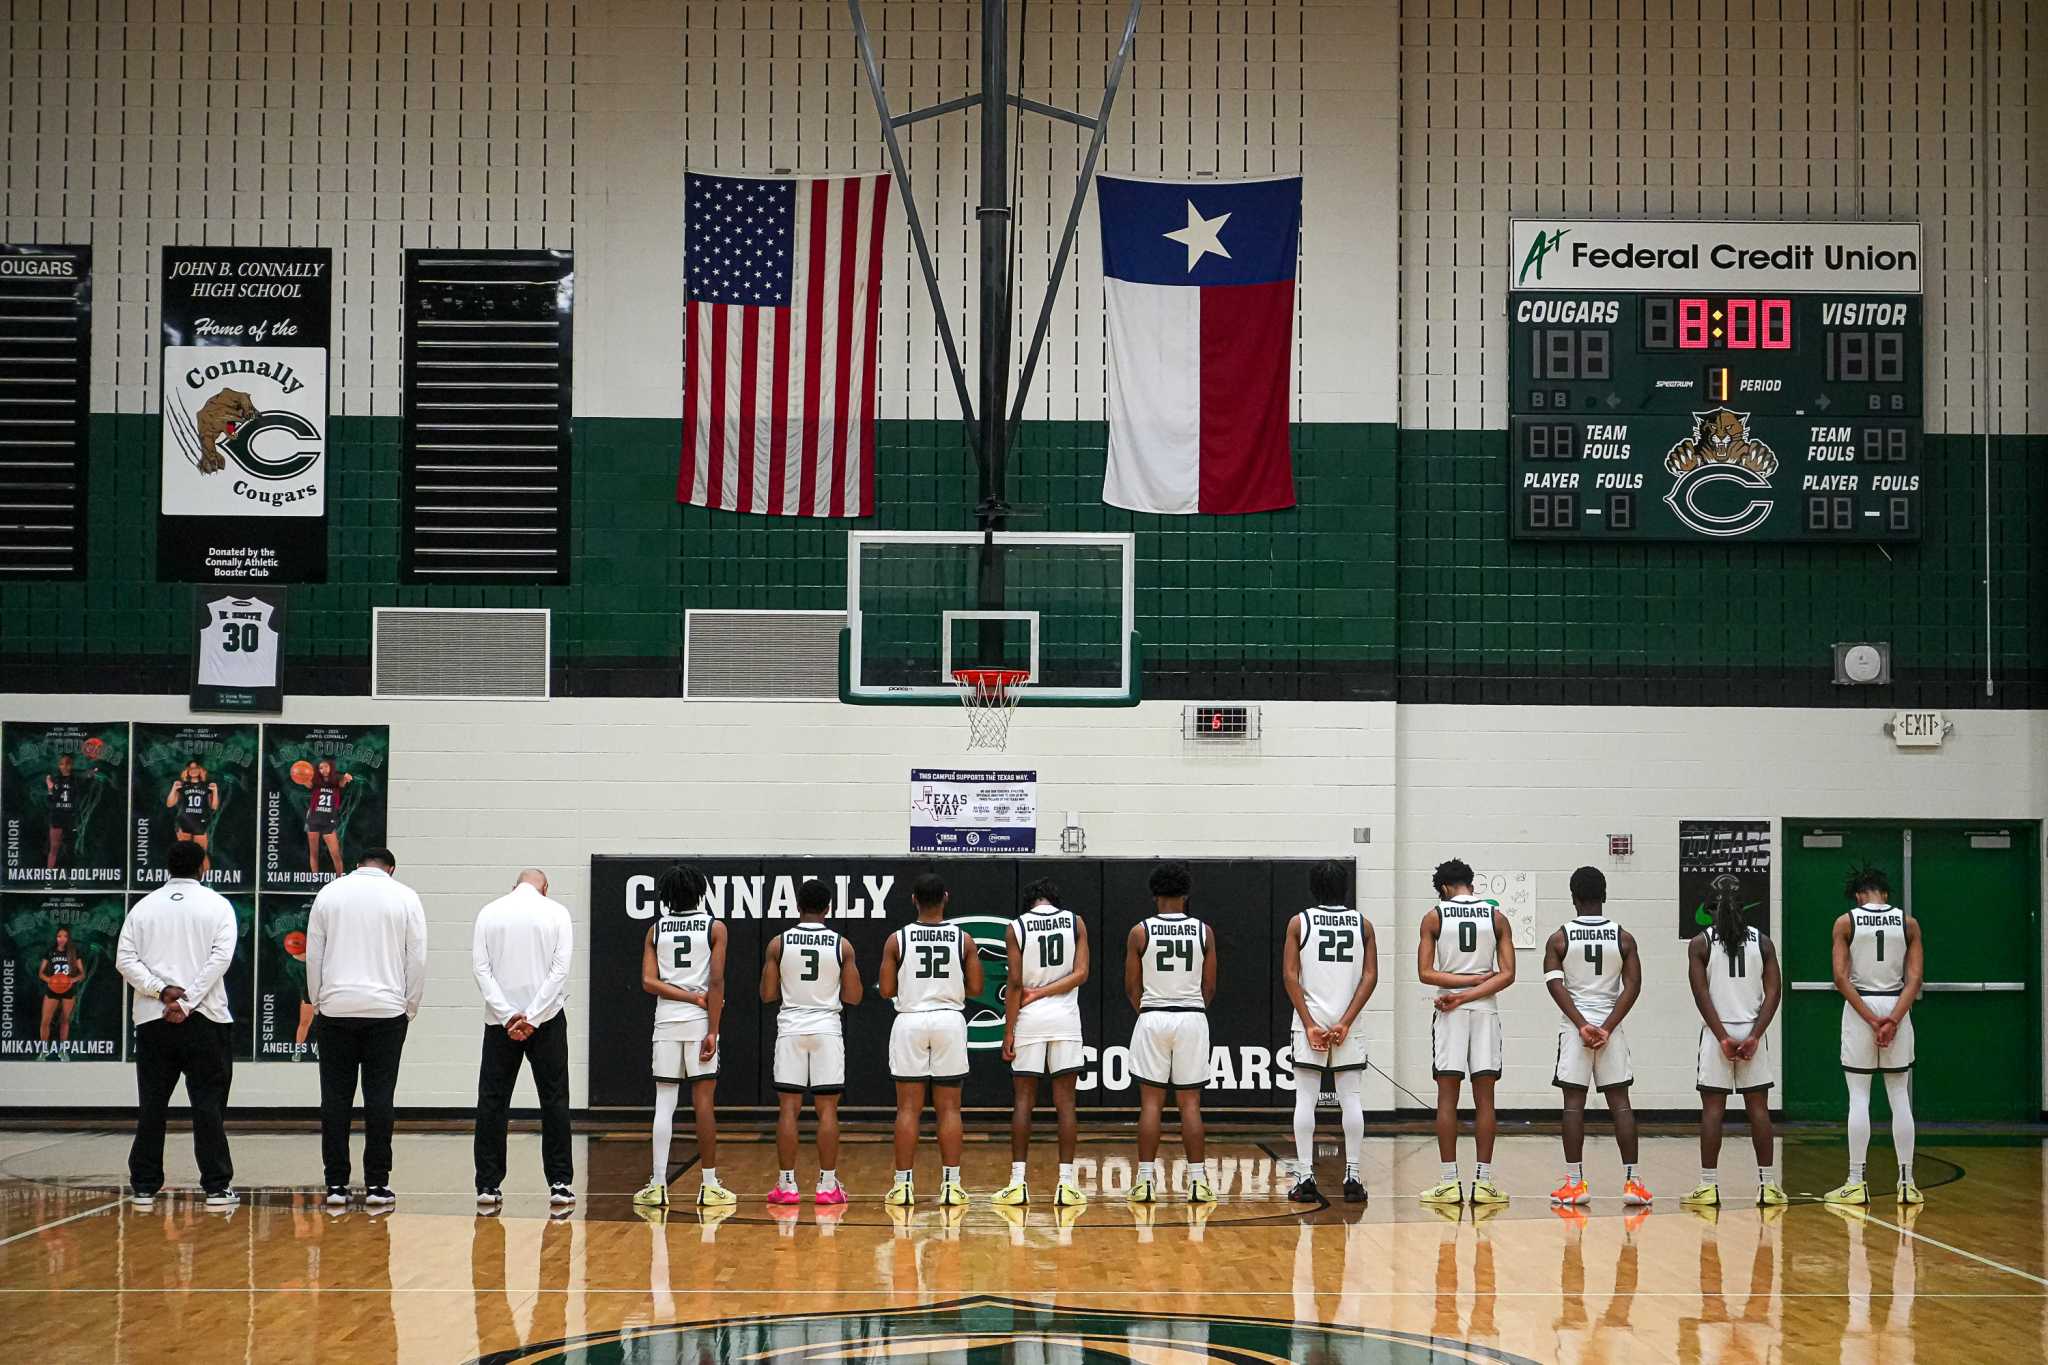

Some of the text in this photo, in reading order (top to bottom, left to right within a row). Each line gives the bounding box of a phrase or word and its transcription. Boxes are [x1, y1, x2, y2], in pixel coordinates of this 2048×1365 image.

[1572, 242, 1698, 269] Federal
[1711, 244, 1814, 269] Credit
[1825, 245, 1917, 270] Union
[0, 260, 73, 276] OUGARS
[169, 261, 325, 279] JOHN B. CONNALLY
[190, 282, 302, 298] HIGH SCHOOL
[1517, 300, 1620, 324] COUGARS
[1822, 303, 1907, 326] VISITOR
[194, 317, 298, 342] Home of the
[1679, 299, 1791, 349] 8:00
[186, 358, 305, 395] Connally
[1740, 379, 1782, 392] PERIOD
[1586, 425, 1628, 441] TEAM
[1810, 427, 1852, 442] TEAM
[1582, 443, 1631, 460] FOULS
[1807, 446, 1855, 461] FOULS
[1523, 472, 1644, 489] PLAYER FOULS
[1802, 475, 1920, 491] PLAYER FOULS
[232, 480, 317, 507] Cougars
[208, 547, 275, 559] Donated by the
[205, 557, 279, 568] Connally Athletic
[214, 568, 269, 577] Booster Club
[222, 622, 259, 653] 30
[1905, 713, 1936, 736] EXIT
[188, 796, 201, 807] 10
[318, 794, 332, 806] 21
[925, 793, 968, 805] TEXAS
[934, 804, 960, 816] WAY
[267, 791, 280, 869] SOPHOMORE
[7, 819, 19, 866] SENIOR
[136, 817, 150, 865] JUNIOR
[8, 868, 121, 880] MAKRISTA DOLPHUS
[136, 868, 171, 882] CARM
[267, 871, 290, 883] XIAH
[293, 872, 338, 883] HOUSTON
[625, 874, 895, 919] CNNALY
[1443, 906, 1490, 918] COUGARS
[661, 920, 706, 933] COUGARS
[1026, 917, 1072, 932] COUGARS
[1313, 914, 1358, 927] COUGARS
[1856, 915, 1902, 927] COUGARS
[910, 929, 956, 942] COUGARS
[1151, 924, 1197, 936] COUGARS
[1458, 921, 1477, 953] 0
[1569, 929, 1616, 941] COUGARS
[786, 933, 835, 947] COUGARS
[1318, 929, 1354, 963] 22
[1875, 929, 1885, 962] 1
[673, 935, 692, 968] 2
[1037, 932, 1064, 968] 10
[1156, 939, 1193, 972] 24
[800, 949, 820, 982] 3
[915, 945, 950, 979] 32
[1584, 944, 1603, 976] 4
[53, 964, 70, 976] 23
[1, 959, 15, 1038] SOPHOMORE
[262, 993, 275, 1040] SENIOR
[1, 1039, 114, 1054] MIKAYLA PALMER
[262, 1042, 307, 1054] ANGELES
[1075, 1046, 1297, 1091] COARS
